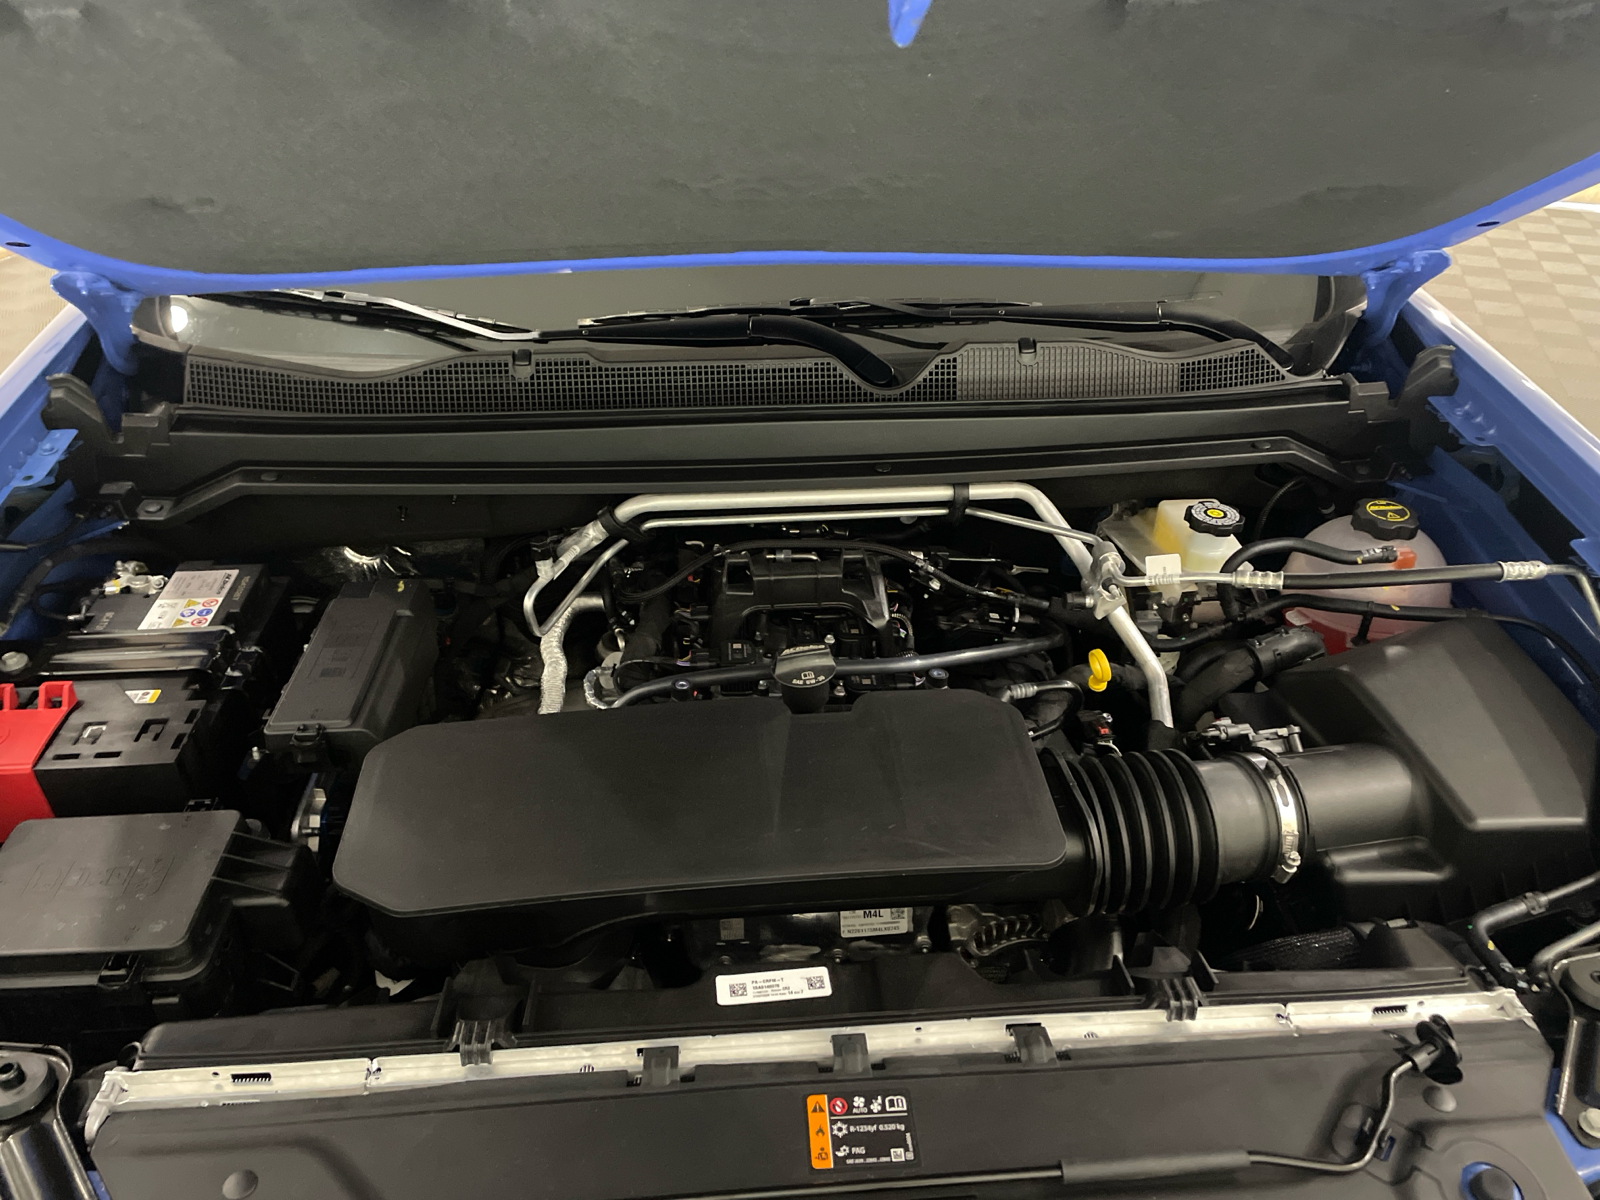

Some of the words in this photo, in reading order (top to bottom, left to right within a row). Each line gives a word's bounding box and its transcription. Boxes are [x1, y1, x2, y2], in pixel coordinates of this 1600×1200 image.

[780, 644, 826, 656] ACDelco
[863, 908, 884, 919] M4L
[849, 1124, 877, 1133] R-1234yf
[896, 1123, 905, 1131] kg
[851, 1146, 866, 1155] PAG
